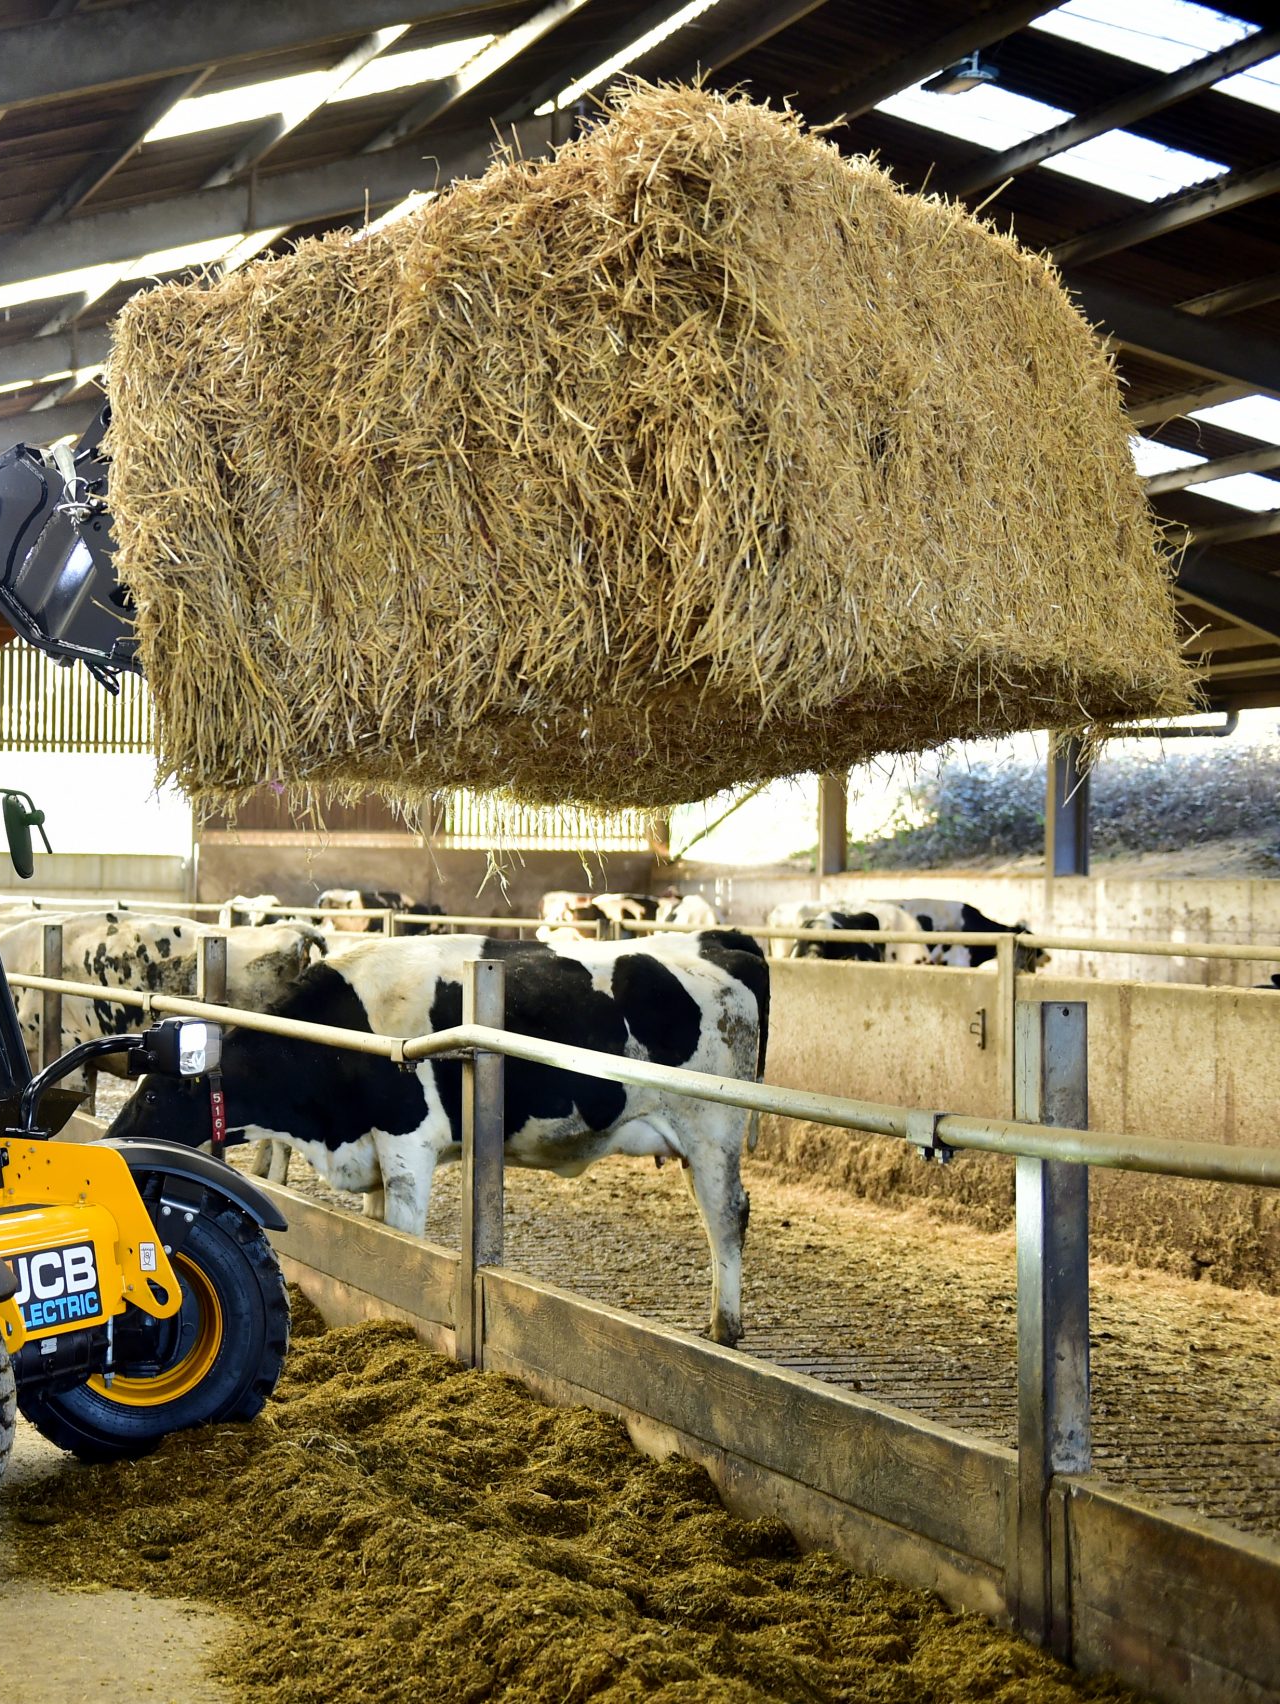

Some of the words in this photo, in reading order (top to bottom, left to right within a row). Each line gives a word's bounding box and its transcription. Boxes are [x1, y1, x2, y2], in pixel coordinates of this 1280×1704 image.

[213, 1093, 222, 1140] 5161
[14, 1246, 97, 1304] JCB
[20, 1291, 99, 1328] LECTRIC
